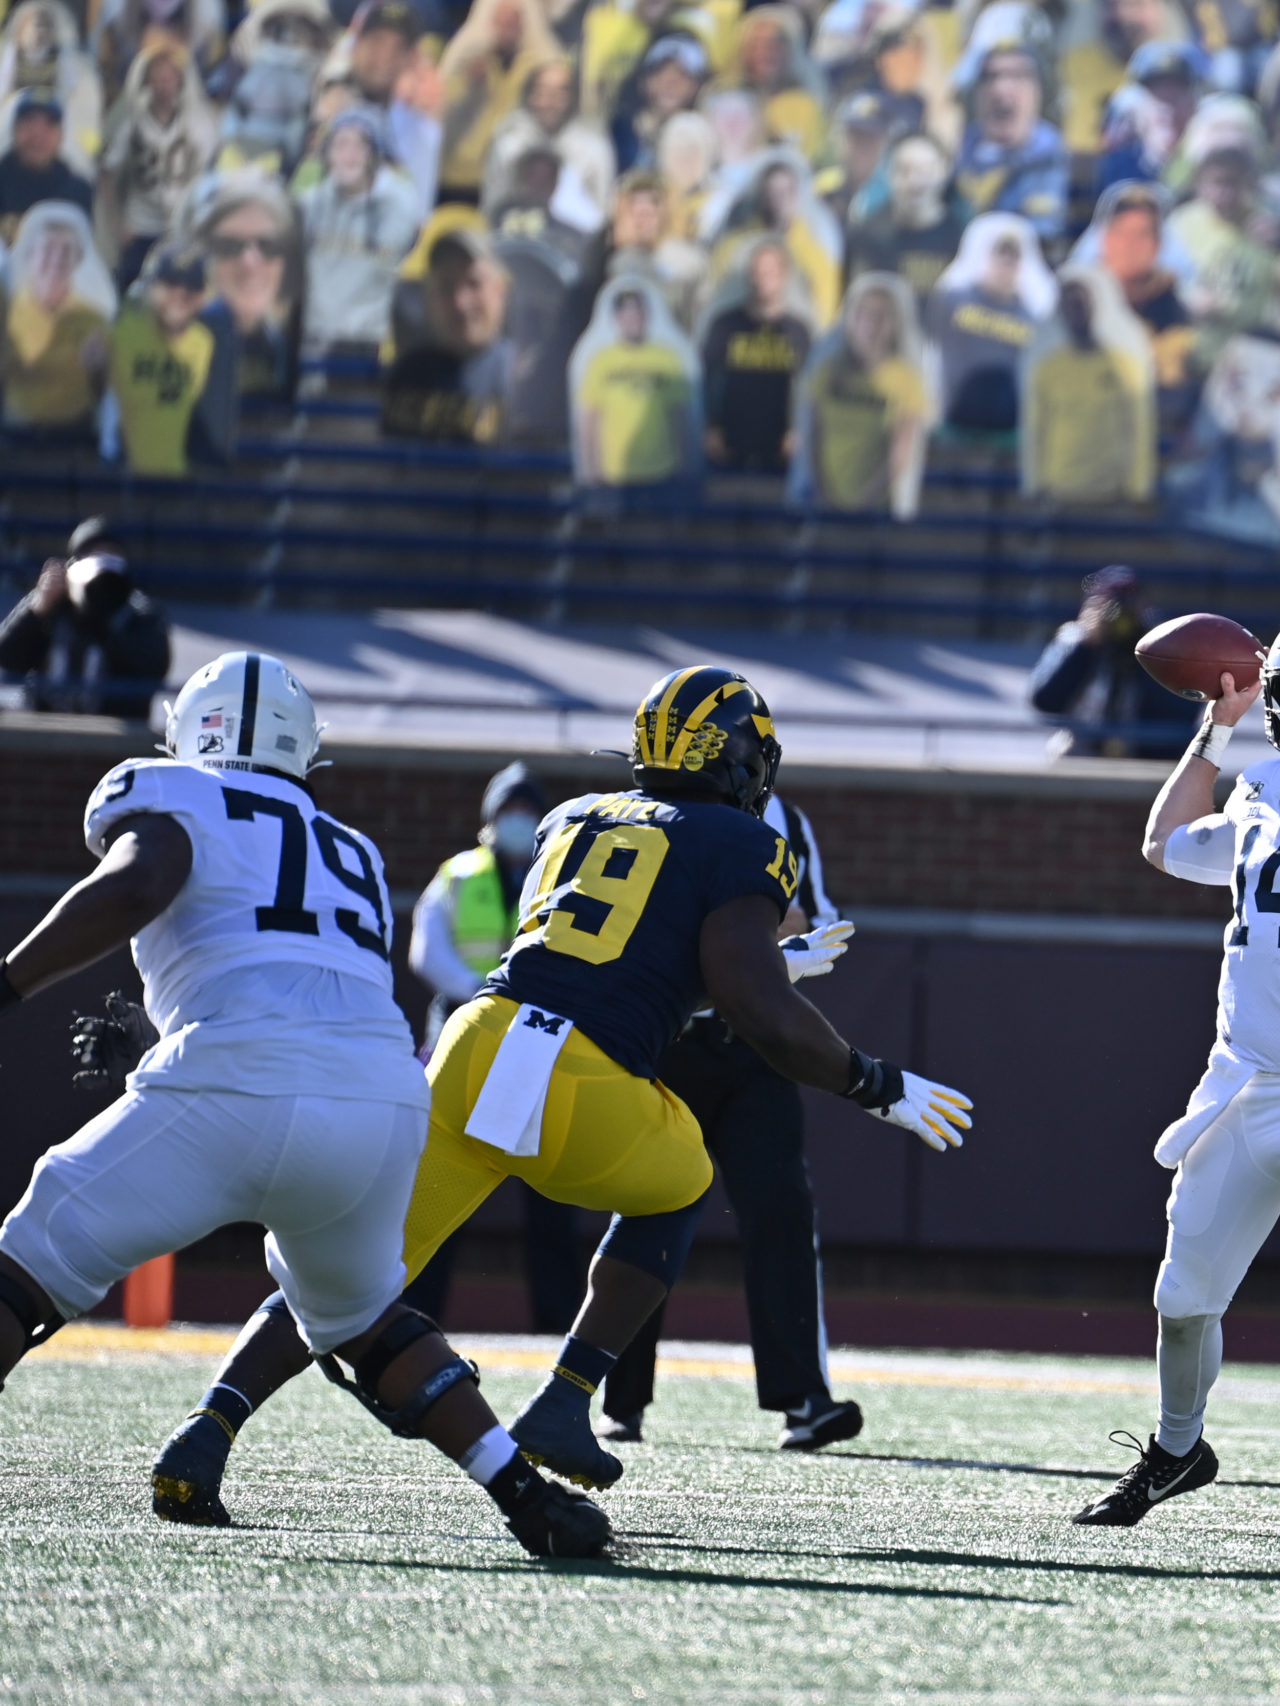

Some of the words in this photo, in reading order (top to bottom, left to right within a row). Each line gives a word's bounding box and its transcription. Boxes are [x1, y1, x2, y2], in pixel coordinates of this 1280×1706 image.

[203, 759, 223, 769] PENN
[225, 760, 250, 771] STATE
[584, 796, 662, 820] PAYE
[221, 786, 390, 963] 79
[765, 837, 798, 899] 19
[522, 822, 670, 965] 19
[523, 1009, 566, 1037] M
